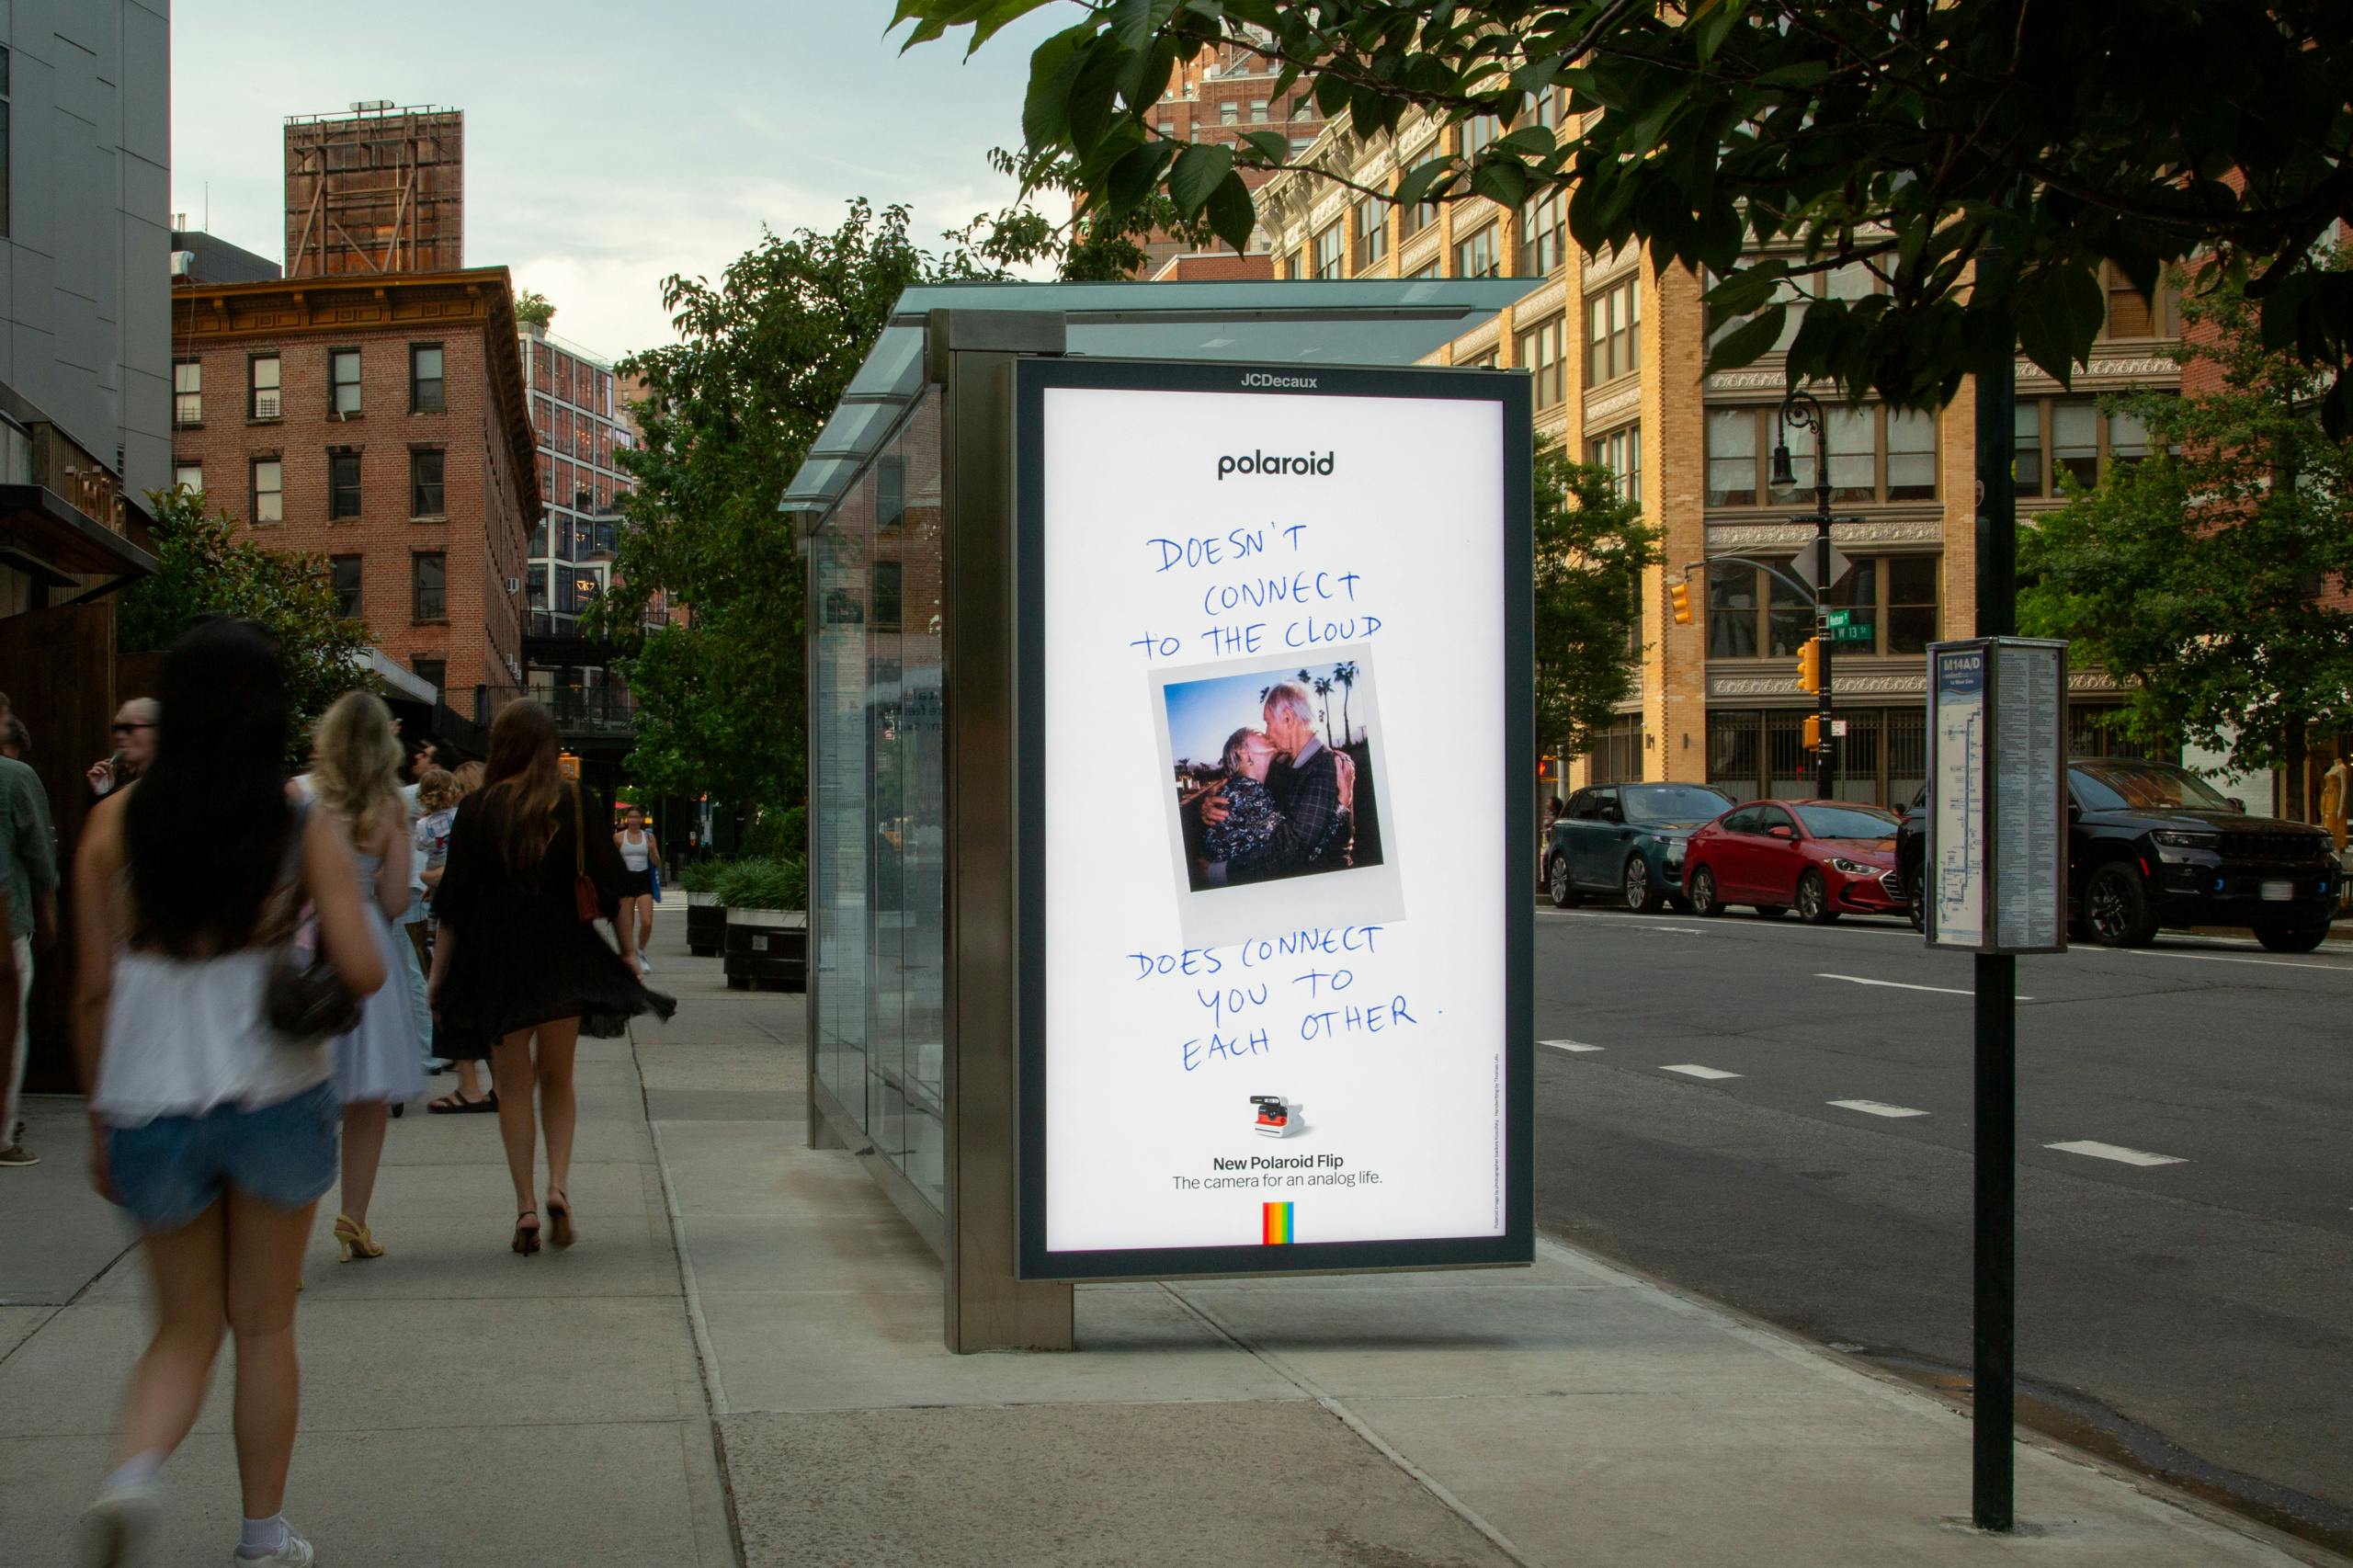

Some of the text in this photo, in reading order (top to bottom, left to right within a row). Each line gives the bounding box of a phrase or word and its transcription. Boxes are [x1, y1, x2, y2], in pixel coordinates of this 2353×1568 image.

[1241, 373, 1318, 388] JCDecaux
[1218, 449, 1335, 481] polaroid
[1147, 522, 1307, 573] DOESN'T
[1204, 572, 1361, 616] CONNECT
[1201, 622, 1266, 656] THE
[1285, 615, 1383, 649] CLOUD
[1838, 628, 1846, 639] W
[1849, 627, 1858, 639] 13
[1944, 657, 1980, 671] M14A/D
[1126, 926, 1383, 980] DOES CONNECT
[1198, 969, 1354, 1028] YOU TO
[1183, 1028, 1270, 1072] EACH
[1173, 1171, 1383, 1189] The camera for an analog life.
[1213, 1153, 1344, 1171] New Polaroid Flip
